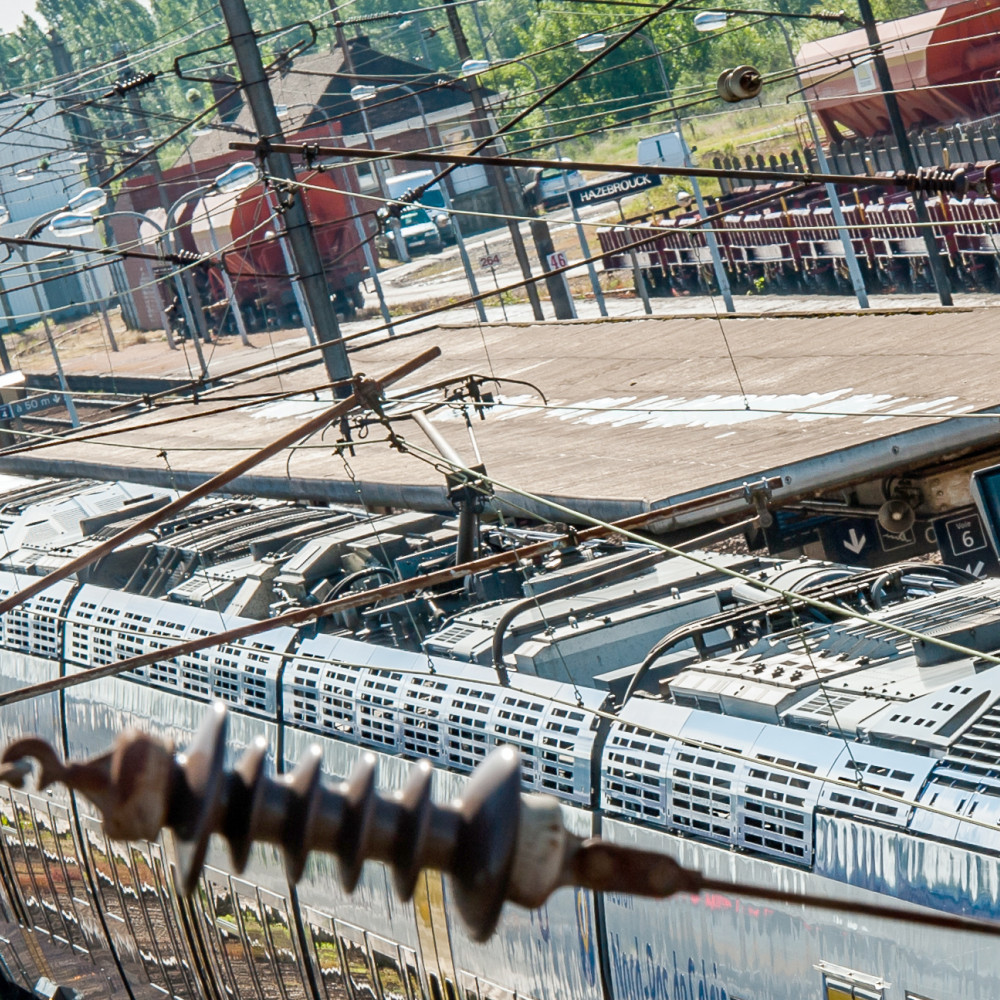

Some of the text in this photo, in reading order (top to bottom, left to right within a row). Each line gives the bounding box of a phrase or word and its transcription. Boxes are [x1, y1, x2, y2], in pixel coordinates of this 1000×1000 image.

[579, 174, 652, 203] HAZEBROUCK
[480, 254, 501, 267] 264
[550, 253, 567, 269] 46
[24, 399, 38, 410] 50
[41, 397, 50, 407] m
[955, 520, 972, 530] Voie
[962, 530, 975, 548] 6
